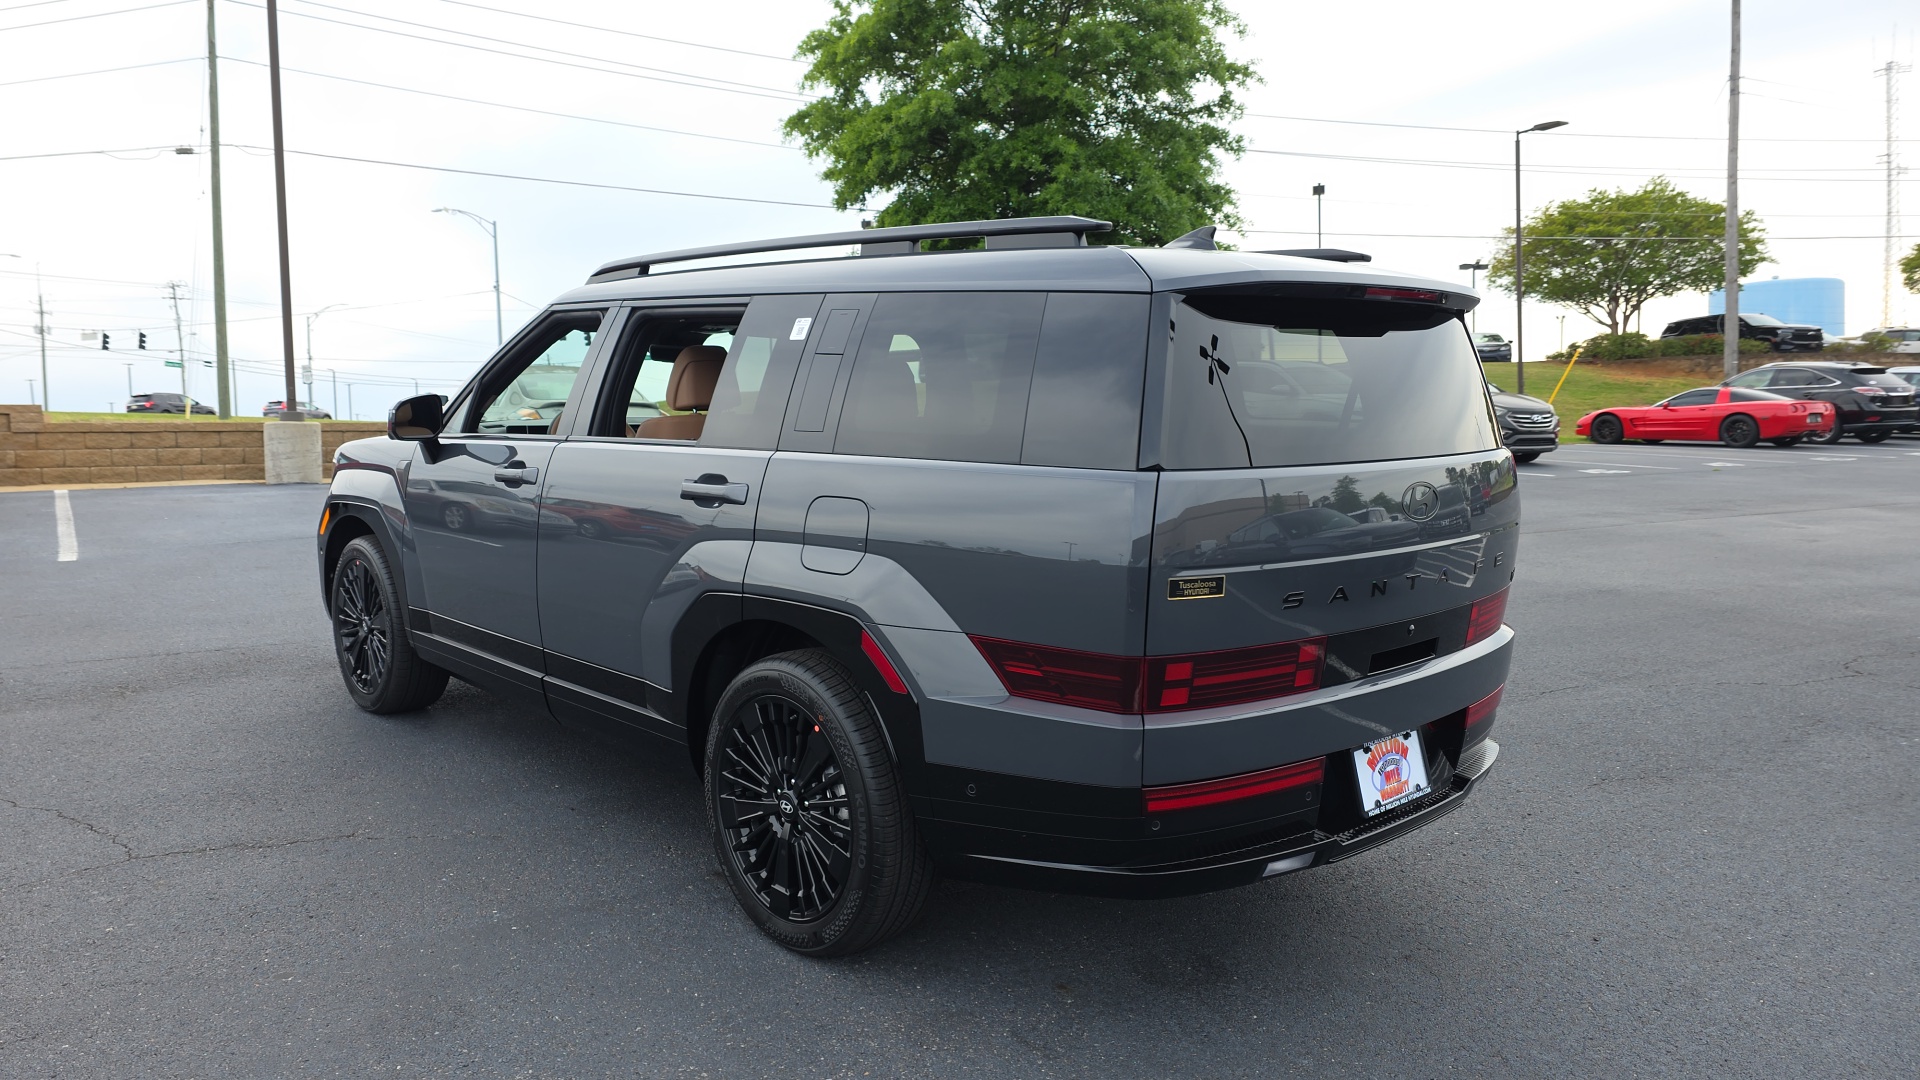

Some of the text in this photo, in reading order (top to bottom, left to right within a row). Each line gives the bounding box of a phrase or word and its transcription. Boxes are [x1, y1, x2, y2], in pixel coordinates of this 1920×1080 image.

[1179, 580, 1216, 589] Tuscaloosa
[1281, 567, 1450, 610] SANTA
[1473, 551, 1504, 574] FE
[1367, 738, 1409, 771] MILLION
[1384, 766, 1401, 786] MILE
[1368, 807, 1380, 816] HOME
[854, 793, 867, 870] KUMHO
